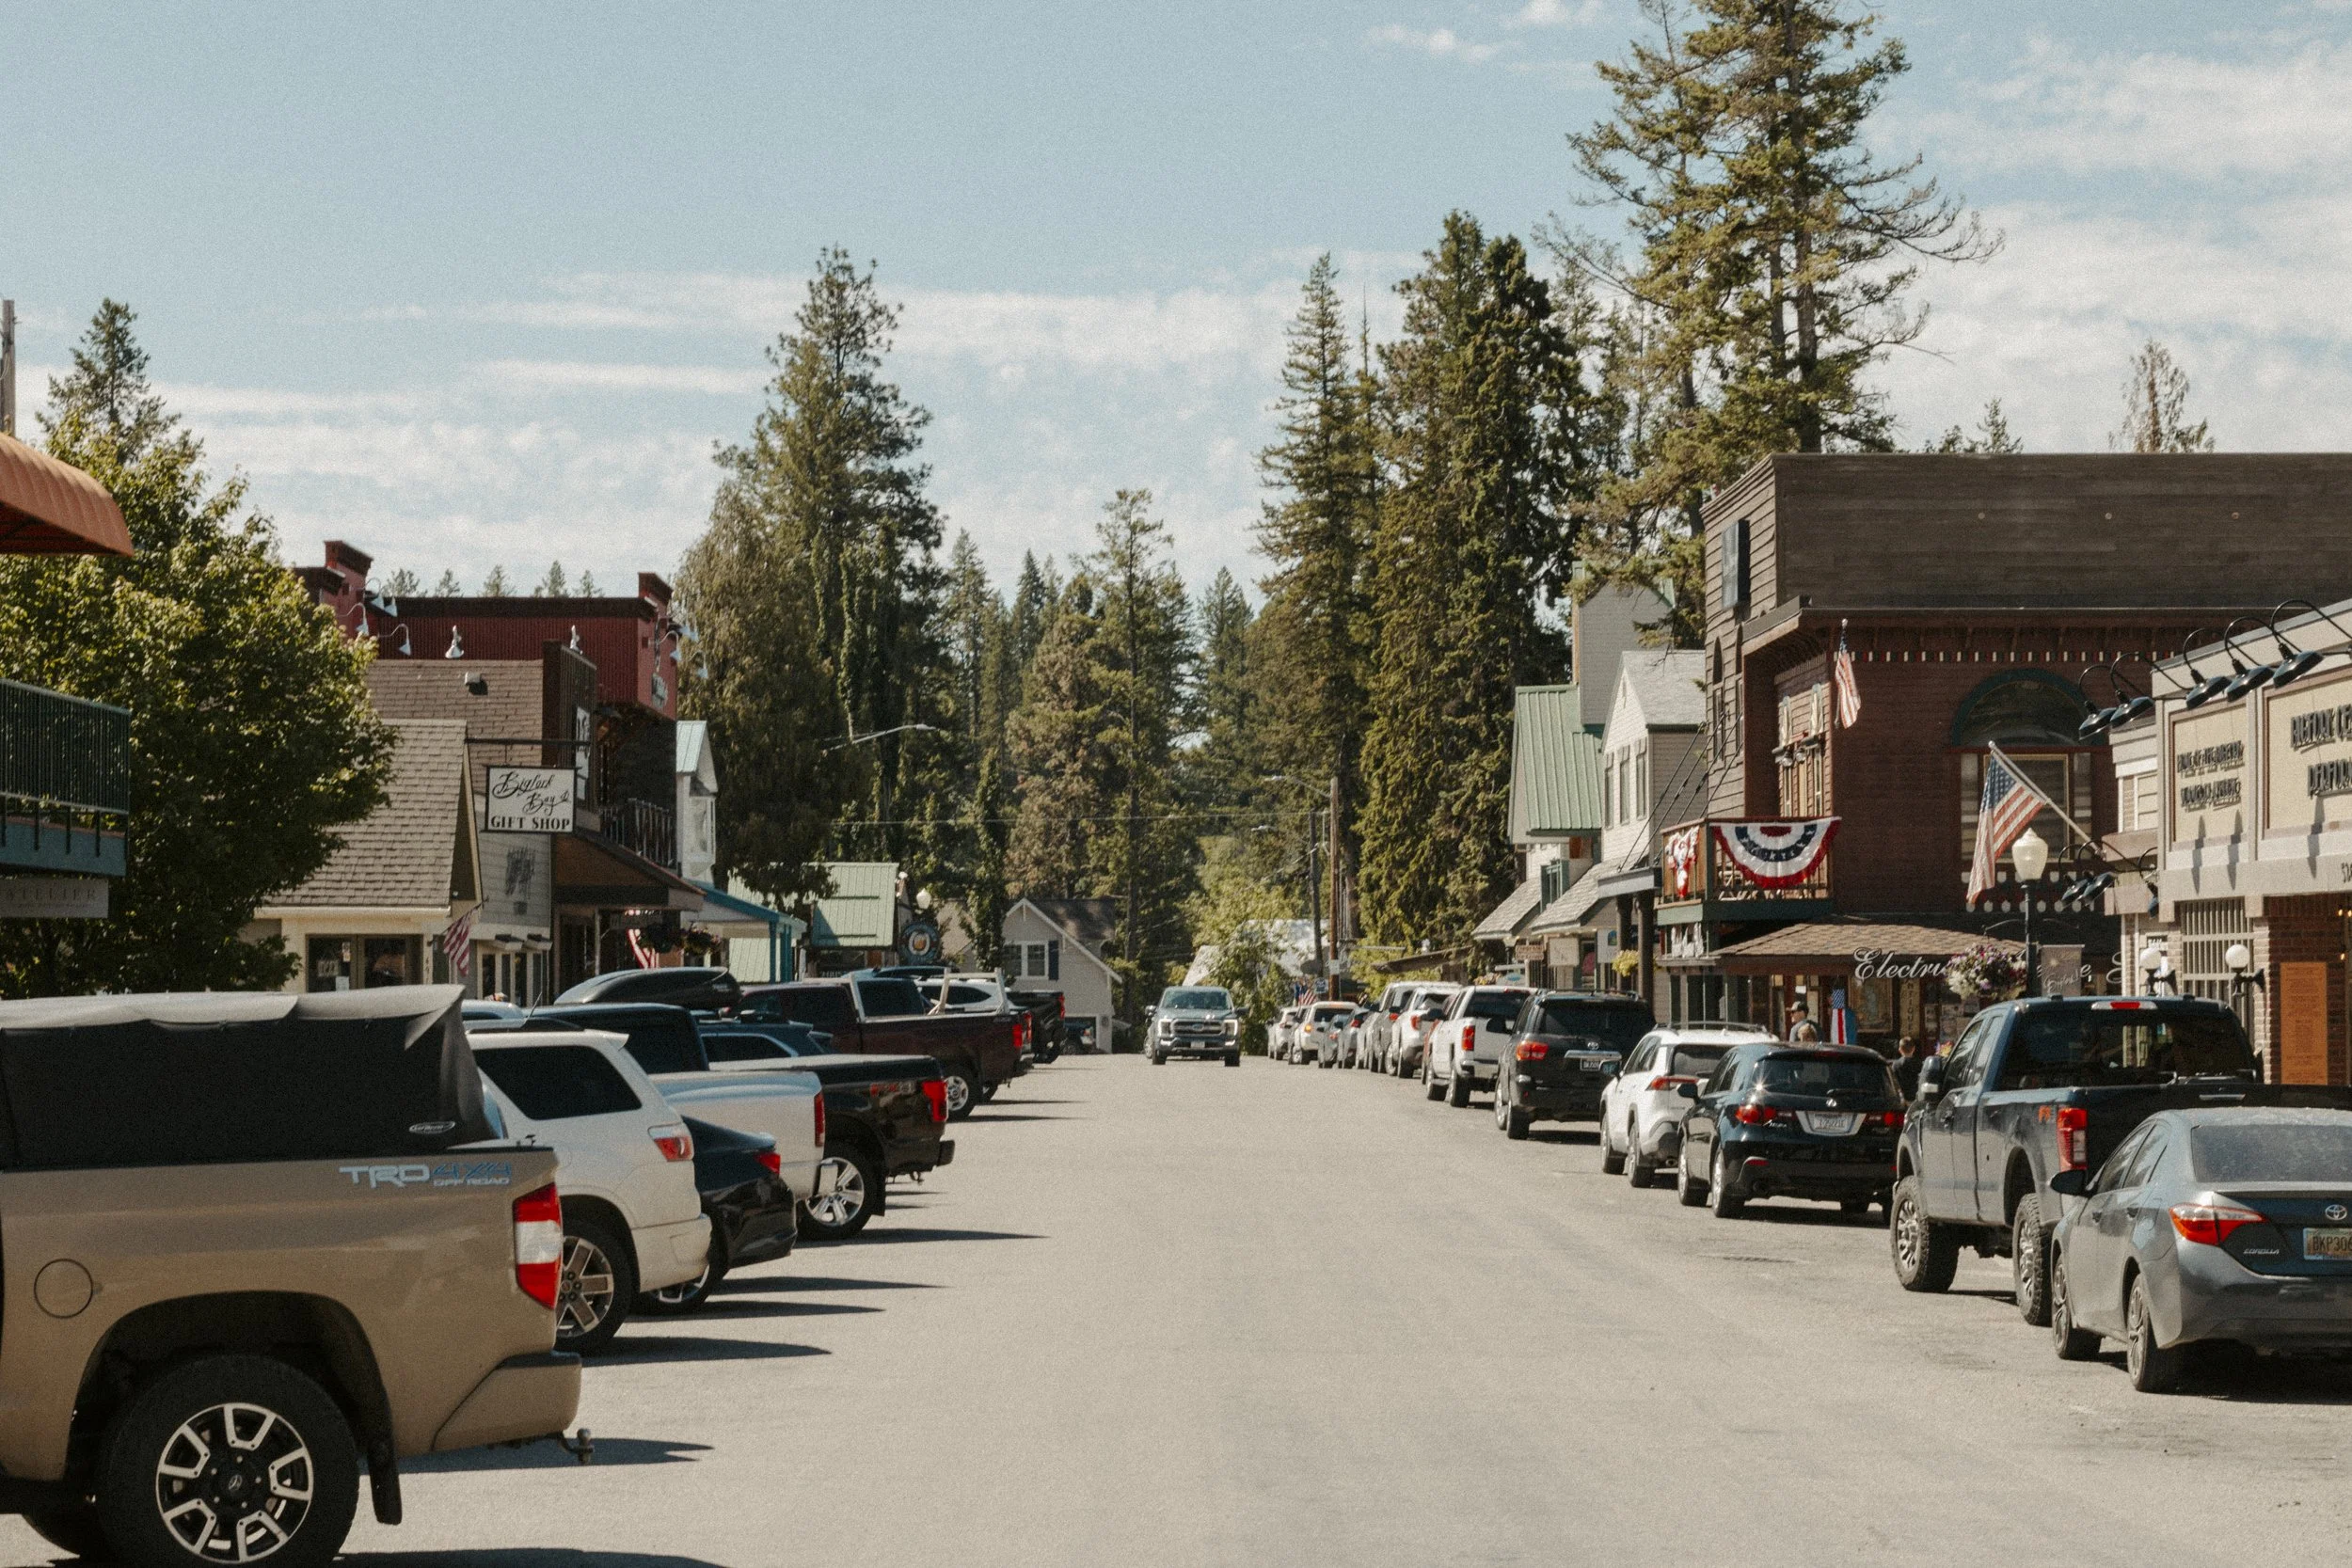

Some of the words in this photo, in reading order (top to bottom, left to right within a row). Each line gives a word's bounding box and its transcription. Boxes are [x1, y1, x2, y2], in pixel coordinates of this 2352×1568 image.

[492, 771, 555, 799] Bigfork
[491, 816, 526, 829] GIFT
[532, 817, 570, 831] SHOP
[1853, 946, 1947, 982] Electri
[339, 1164, 430, 1188] TRD
